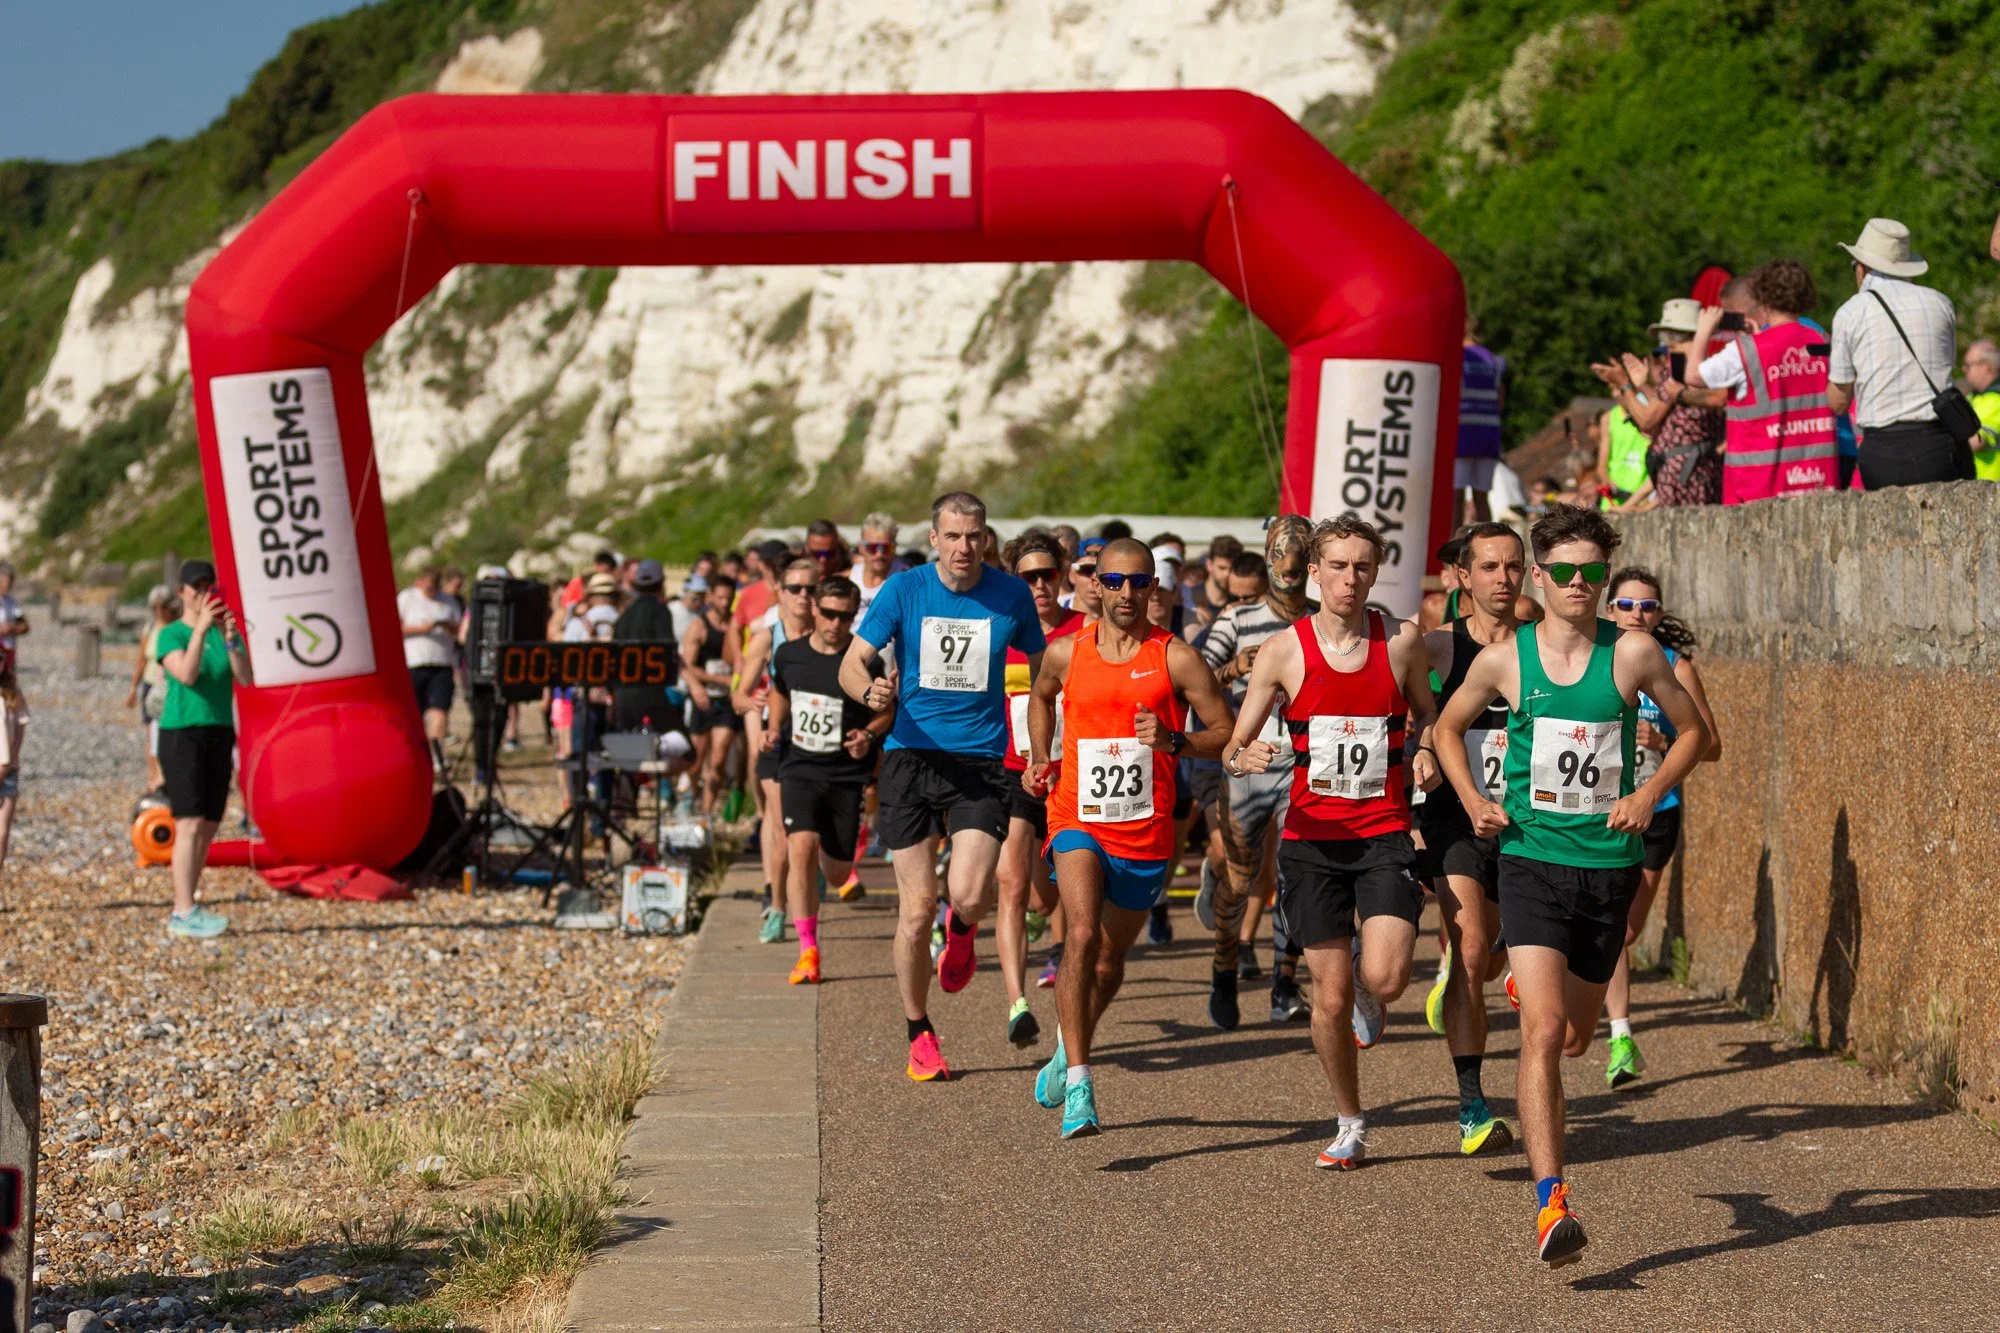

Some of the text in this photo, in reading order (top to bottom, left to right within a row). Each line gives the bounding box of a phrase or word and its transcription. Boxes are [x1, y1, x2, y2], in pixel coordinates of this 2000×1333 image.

[674, 138, 972, 201] FINISH
[1767, 356, 1826, 382] parkrun
[1766, 416, 1834, 438] VOUNTEE
[269, 377, 329, 576] SYSTEMS
[1341, 418, 1377, 521] ORT
[244, 436, 293, 580] SPORT
[503, 647, 667, 685] 00:00:05
[940, 635, 973, 664] 97
[799, 710, 833, 736] 265
[1337, 743, 1369, 776] 19
[1484, 756, 1507, 790] 2
[1557, 750, 1600, 789] 96
[1090, 763, 1144, 799] 323
